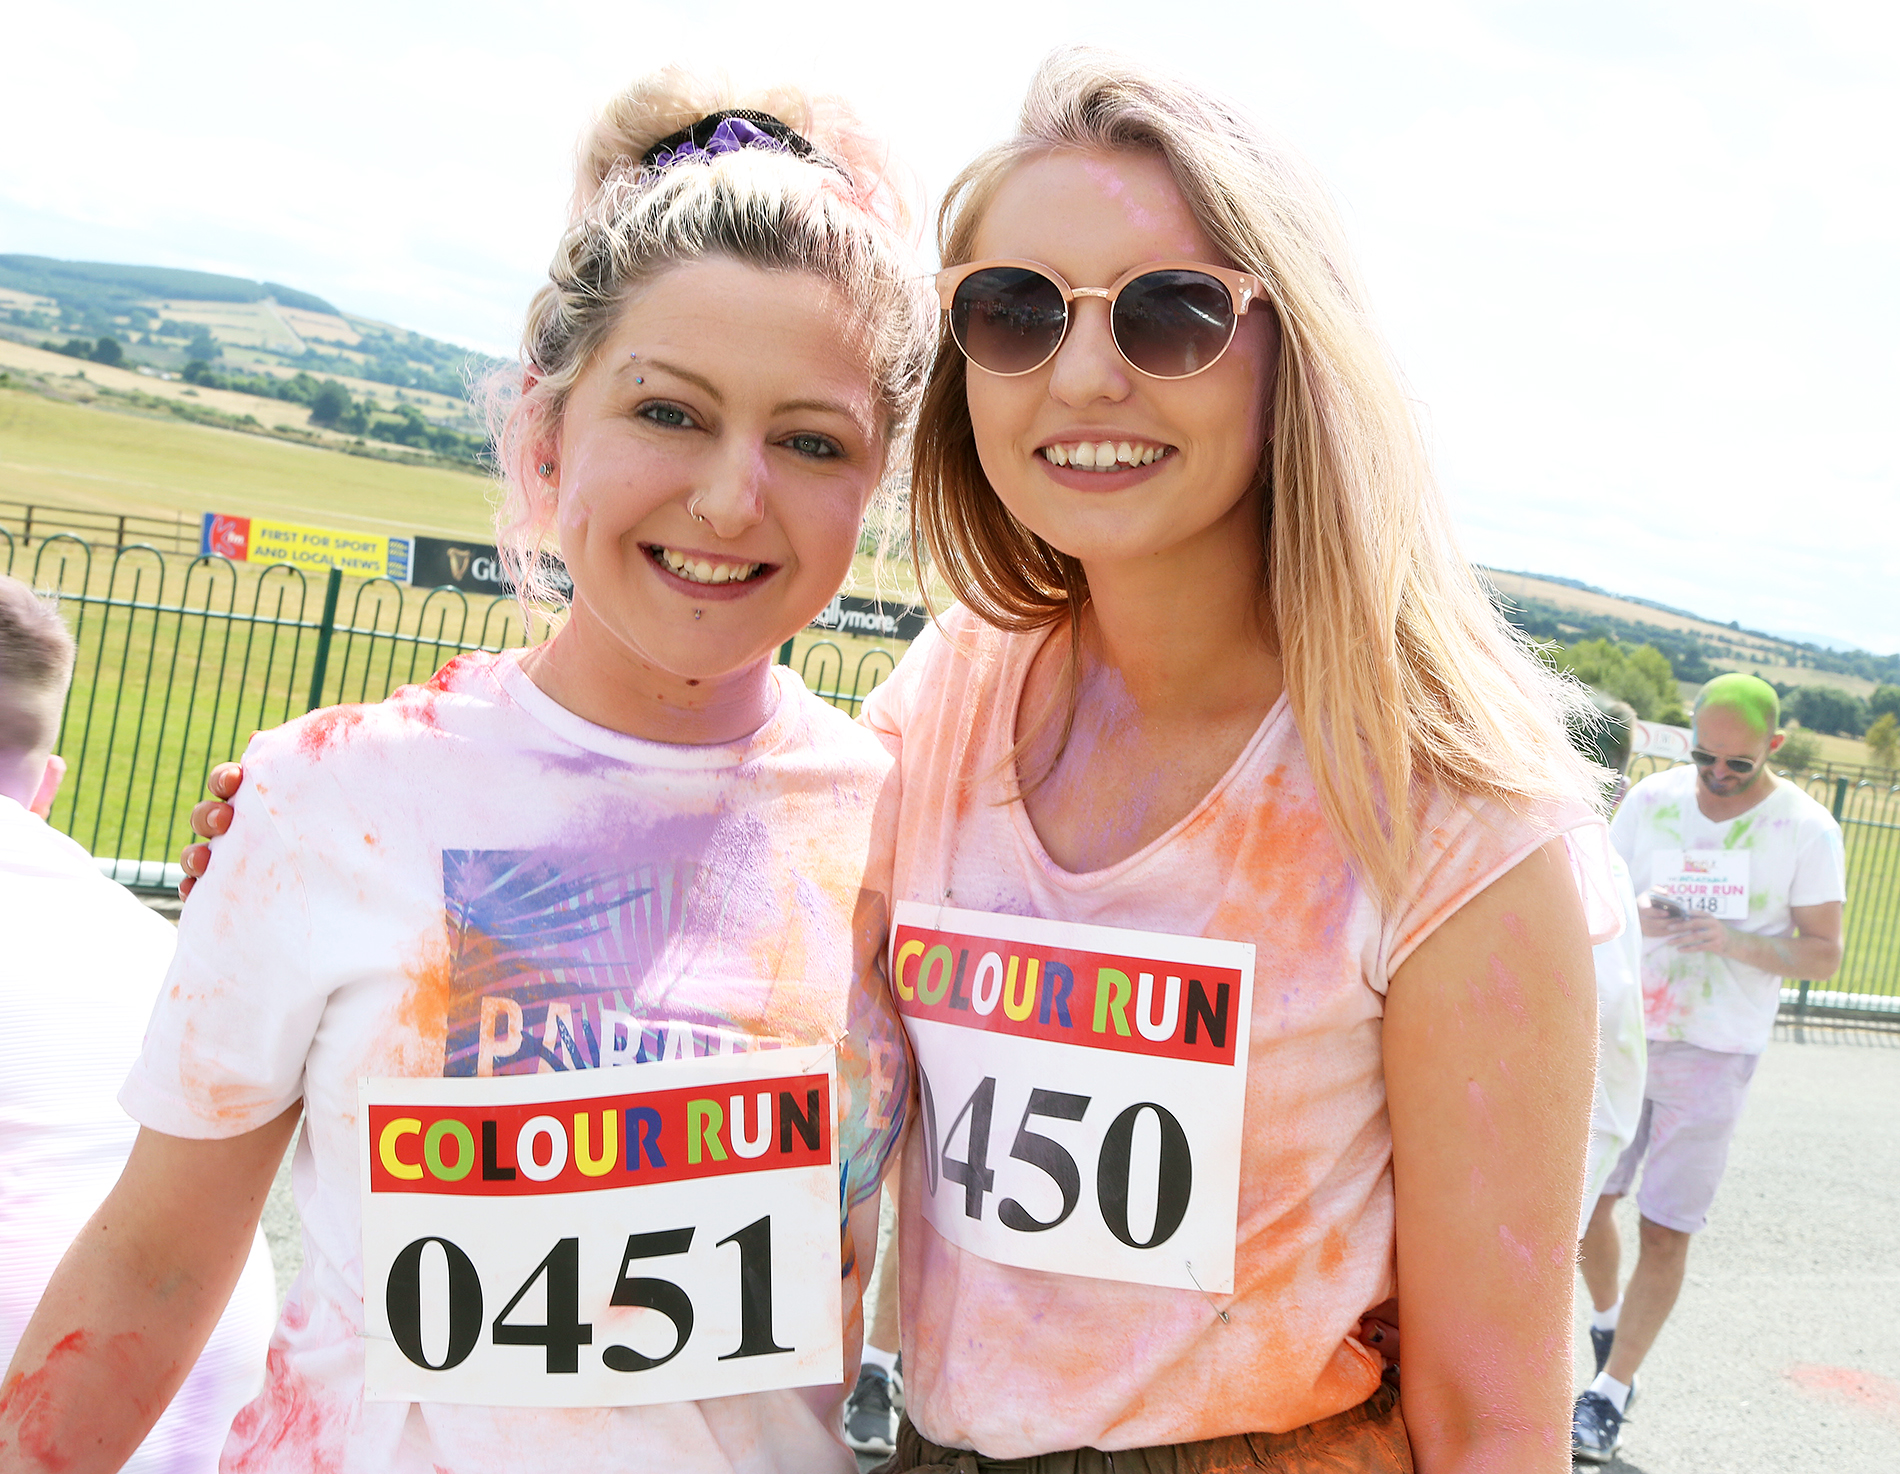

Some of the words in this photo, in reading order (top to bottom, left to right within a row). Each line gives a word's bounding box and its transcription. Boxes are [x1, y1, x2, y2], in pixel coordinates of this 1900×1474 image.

[254, 545, 288, 559] AND
[292, 550, 336, 566] LOCAL
[341, 557, 381, 572] NEWS
[261, 529, 298, 543] FIRST
[302, 534, 330, 547] FOR
[334, 539, 378, 554] SPORT
[819, 594, 899, 632] allymore.
[1657, 884, 1708, 896] OLOUR
[1712, 885, 1744, 895] RUN
[895, 939, 1075, 1029] COLOUR
[1091, 967, 1231, 1049] RUN
[378, 1105, 668, 1182] COLOUR
[686, 1088, 822, 1165] RUN
[918, 1062, 1193, 1250] 0450
[385, 1213, 796, 1375] 0451
